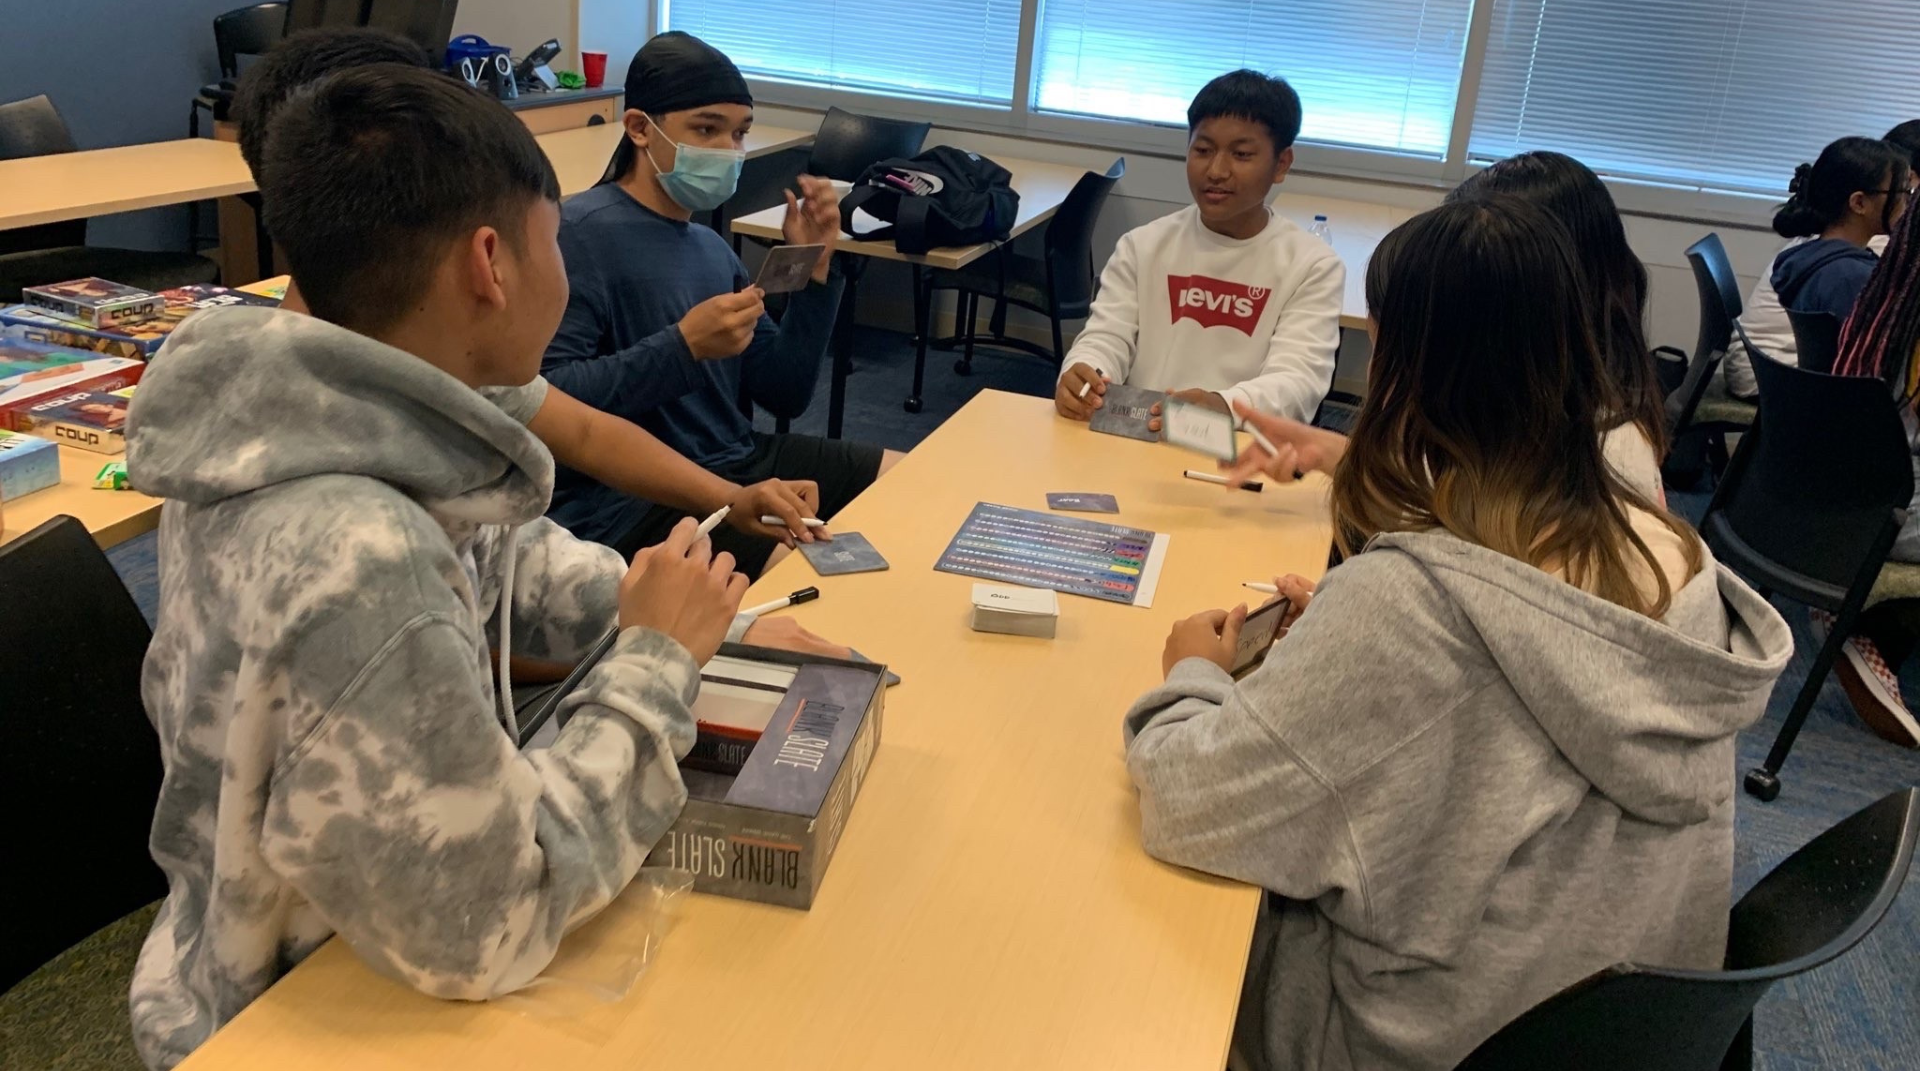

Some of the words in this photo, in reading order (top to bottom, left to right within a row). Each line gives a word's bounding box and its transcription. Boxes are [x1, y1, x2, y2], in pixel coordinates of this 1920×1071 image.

[792, 700, 845, 738] BLANK
[718, 742, 747, 765] SLATE
[773, 733, 829, 772] SLATE
[667, 830, 725, 878] SLATE
[732, 841, 800, 889] BLANK
